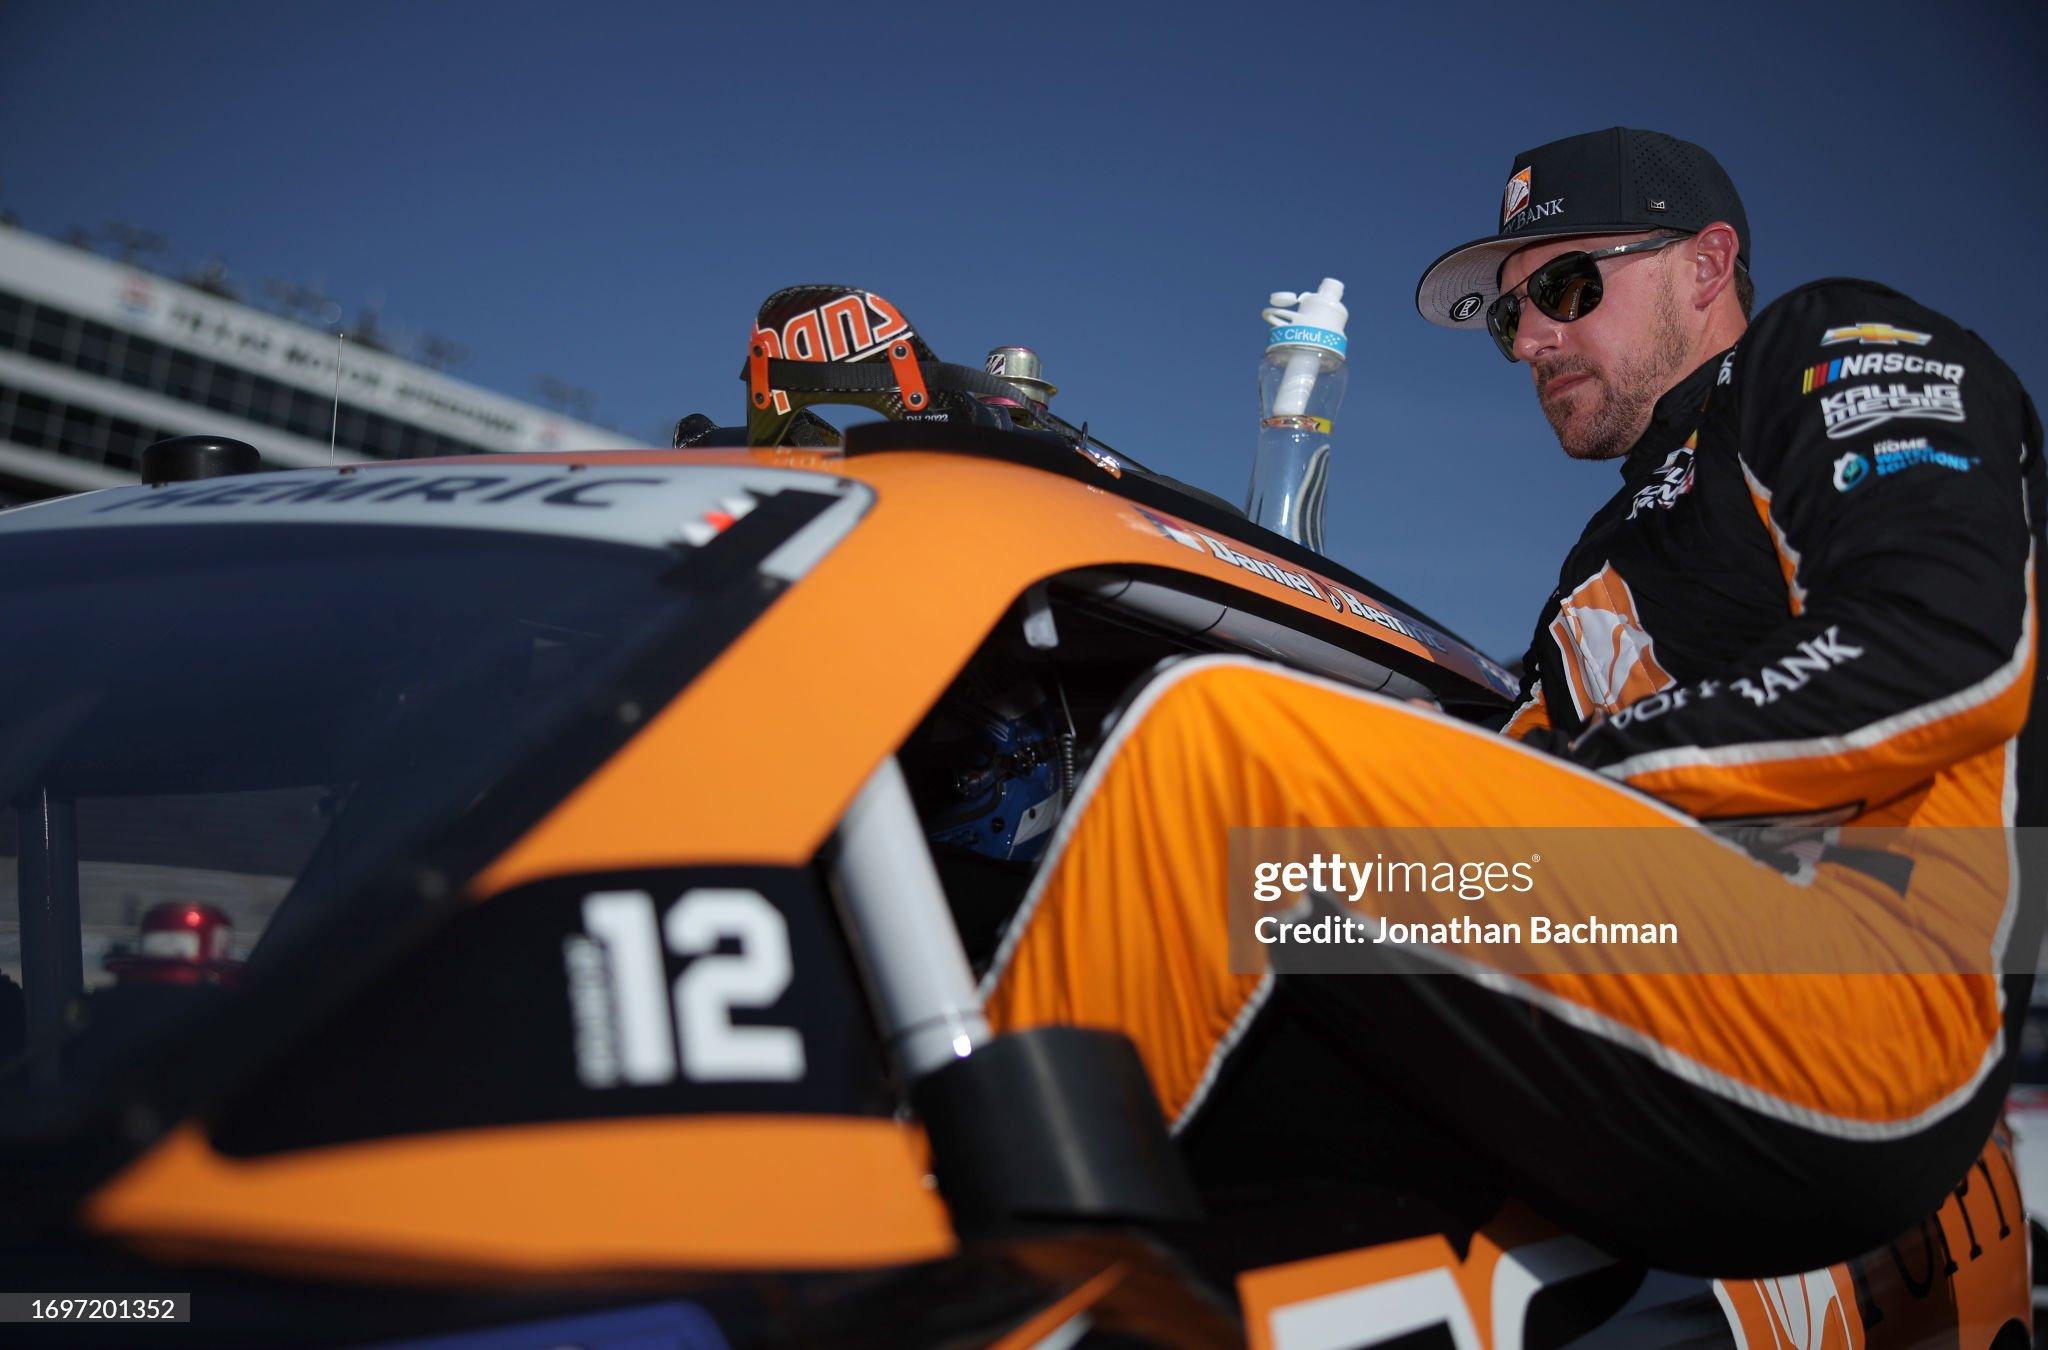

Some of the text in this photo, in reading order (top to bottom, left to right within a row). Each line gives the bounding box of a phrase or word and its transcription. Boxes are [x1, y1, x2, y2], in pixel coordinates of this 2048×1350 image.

[1284, 328, 1321, 343] Cirkul
[1840, 353, 1965, 385] NASCAR
[1820, 384, 1961, 415] KAULIG
[1873, 438, 1927, 455] HOME
[1193, 531, 1326, 602] Daniel
[581, 886, 807, 1086] 12
